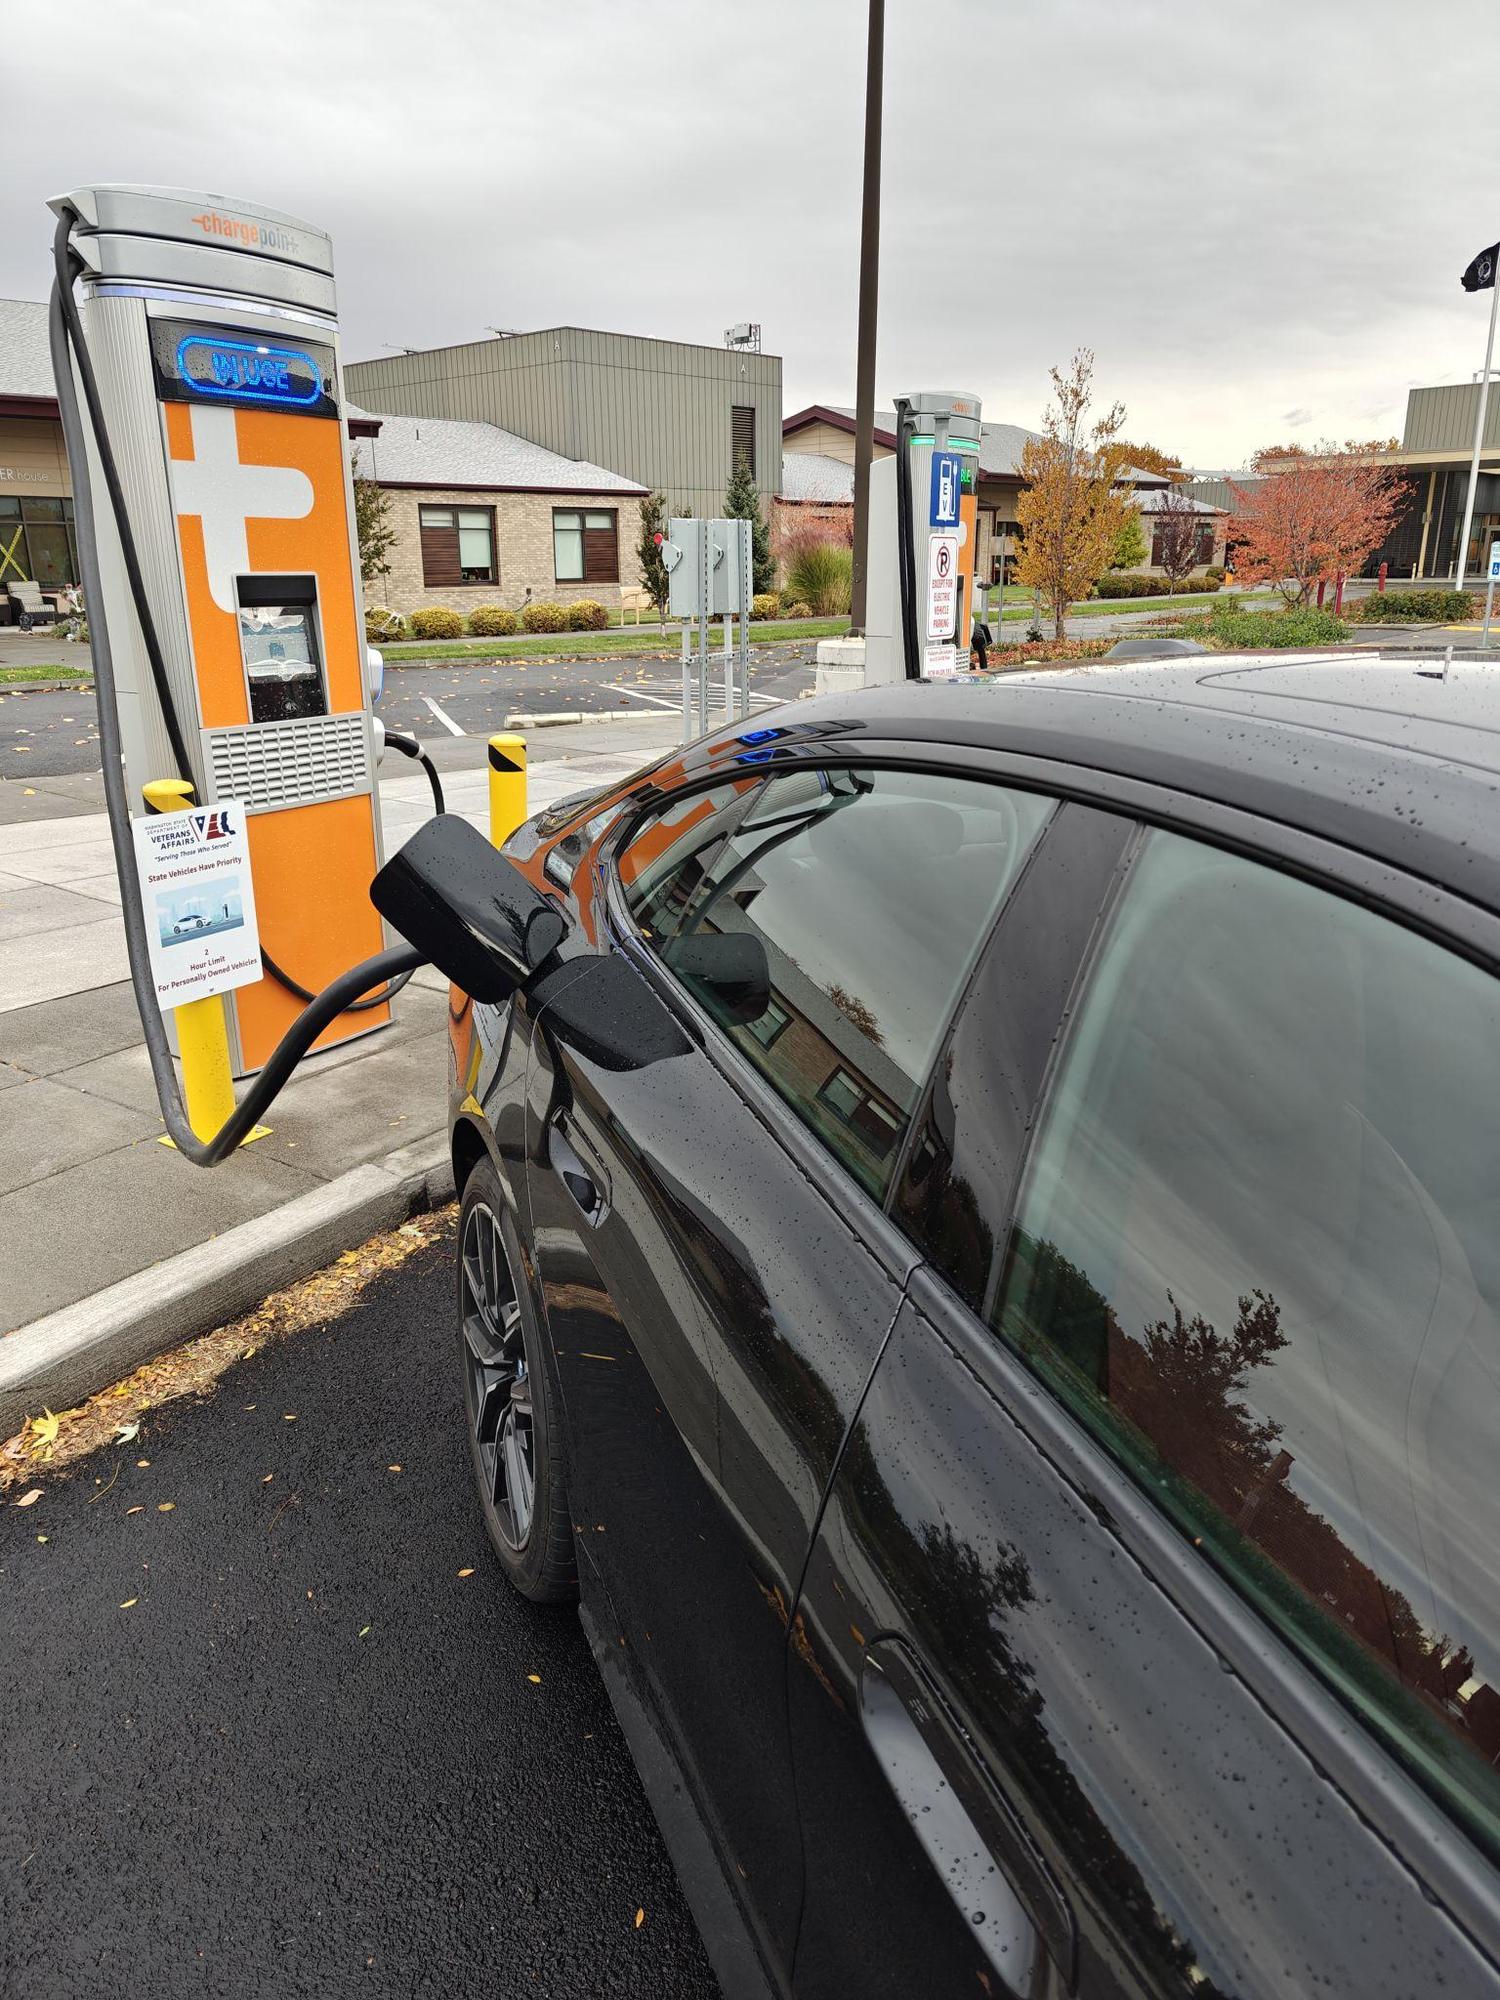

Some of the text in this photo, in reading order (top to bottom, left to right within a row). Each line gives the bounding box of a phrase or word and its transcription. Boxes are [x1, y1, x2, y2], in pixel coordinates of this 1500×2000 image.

[243, 356, 289, 390] USE
[17, 470, 48, 481] house
[151, 830, 191, 843] VETERANS
[160, 837, 195, 850] AFFAIRS
[148, 857, 242, 883] State Vehicles Have Priority
[204, 948, 209, 956] 2
[190, 955, 225, 972] Hour Limit
[158, 958, 258, 993] For Personally Owned Vehicles
